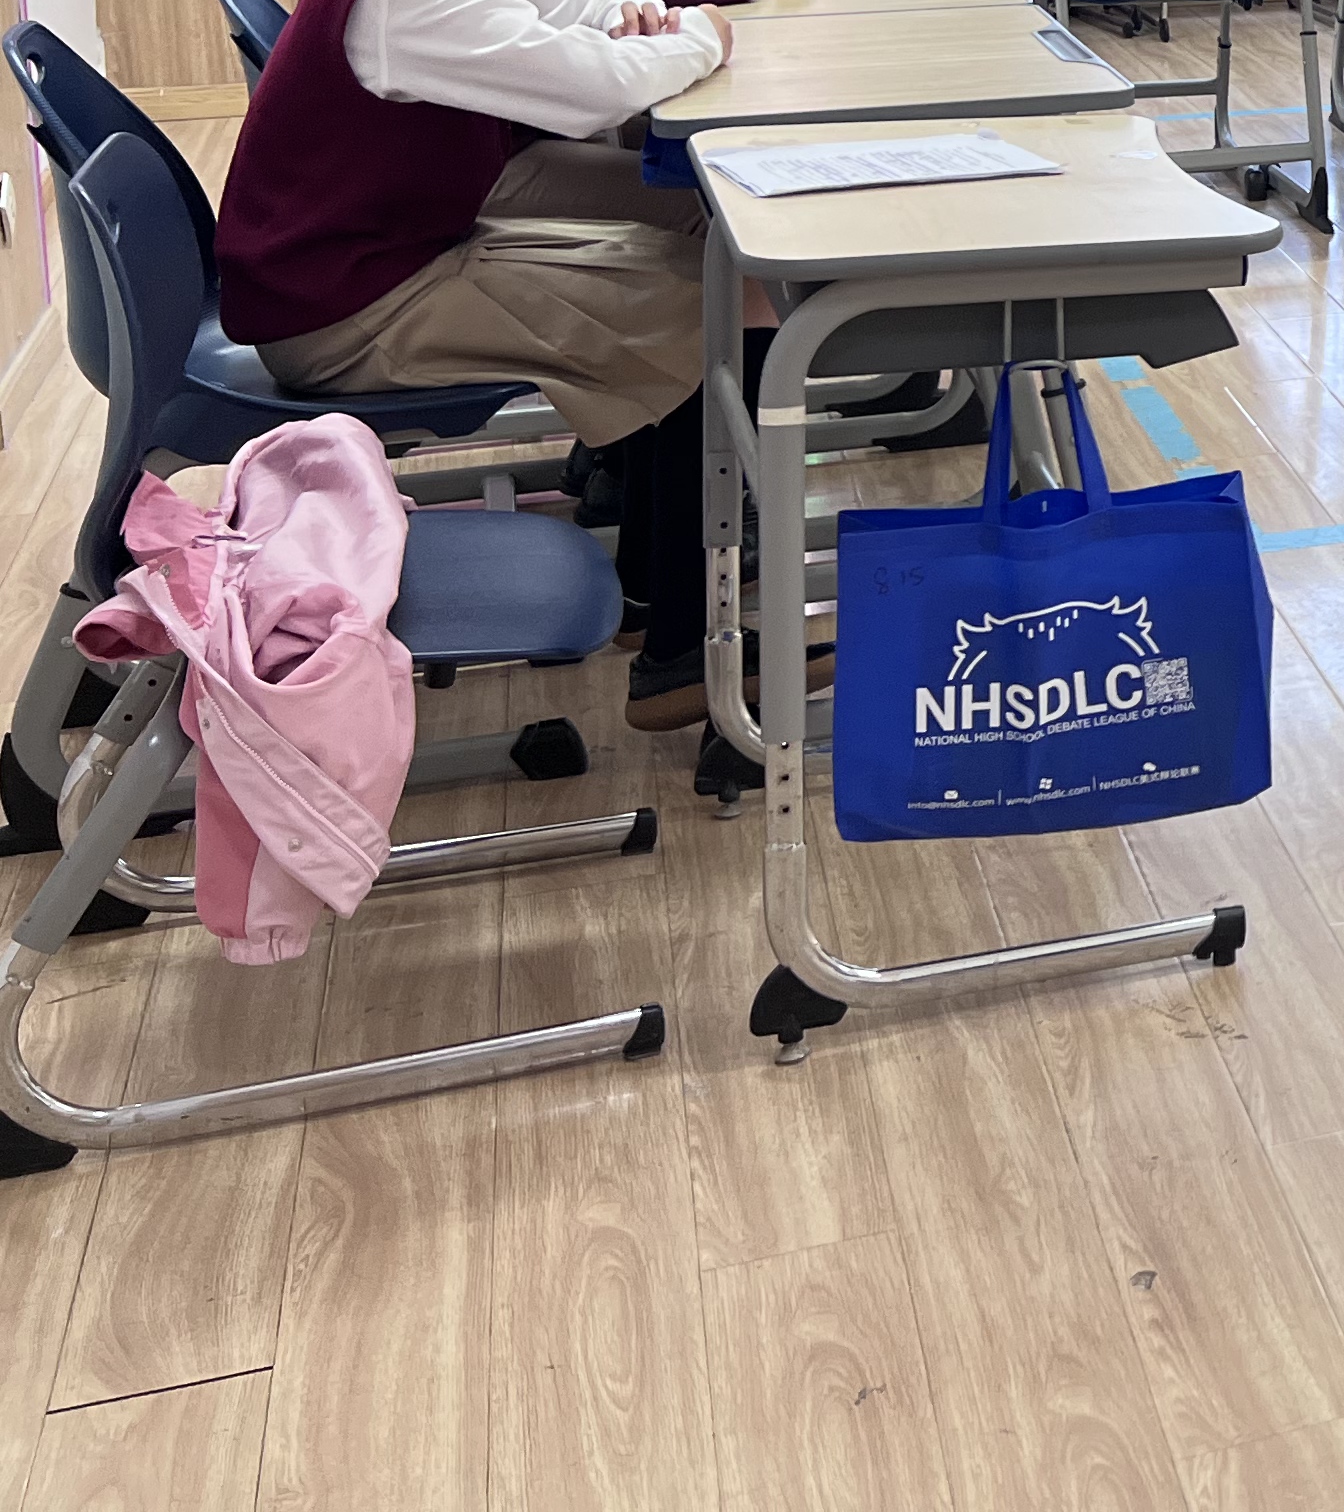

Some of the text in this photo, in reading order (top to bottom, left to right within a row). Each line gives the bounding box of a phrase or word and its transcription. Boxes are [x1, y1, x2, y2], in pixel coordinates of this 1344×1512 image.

[914, 701, 1196, 747] NATIONAL HIGH SCHOOL DEBATE LEAGUE OF CHINA
[915, 663, 1144, 734] NHSDLC
